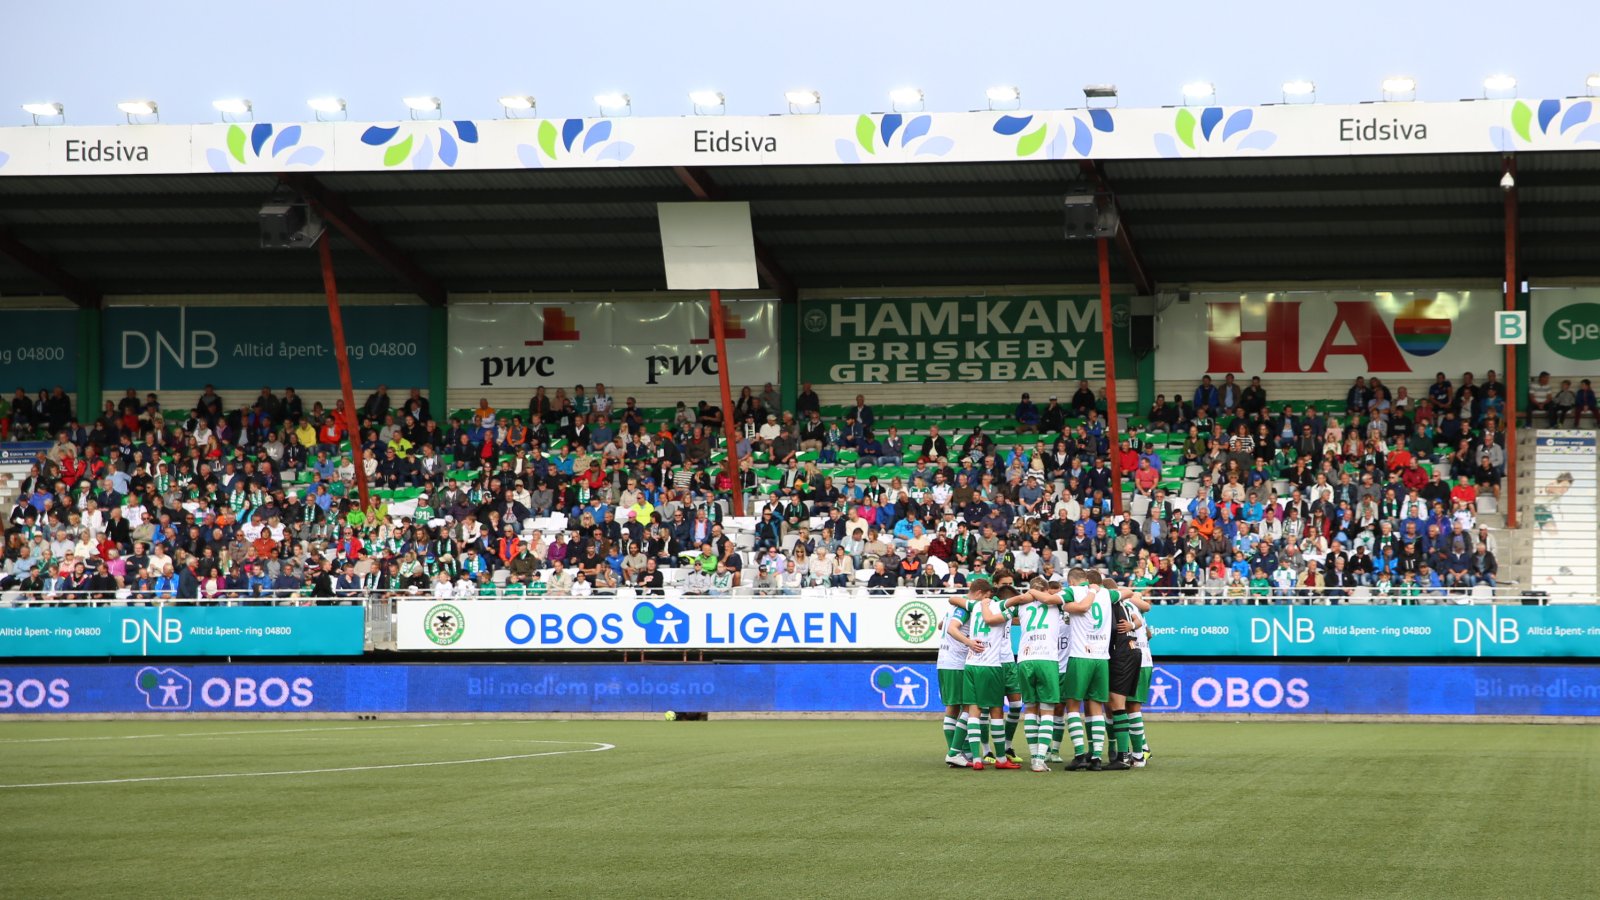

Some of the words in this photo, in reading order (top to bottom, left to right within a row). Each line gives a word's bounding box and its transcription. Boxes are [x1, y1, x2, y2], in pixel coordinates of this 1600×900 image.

[694, 129, 777, 153] Eidsiva
[1340, 118, 1427, 142] Eidsiva
[66, 139, 149, 162] Eidsiva
[830, 299, 1105, 336] HAM-KAM
[1500, 314, 1522, 339] B
[1557, 319, 1600, 345] Spe
[0, 349, 12, 365] g
[17, 347, 65, 361] 04800
[121, 306, 219, 390] DNB
[233, 342, 274, 357] Alltid
[369, 342, 417, 357] 04800
[849, 339, 1086, 361] BRISKEBY
[480, 355, 555, 386] pwc
[646, 354, 719, 385] pwc
[829, 360, 1107, 383] GRESSBANE
[973, 612, 991, 637] 14
[1026, 603, 1049, 632] 22
[1091, 601, 1103, 630] 9
[0, 627, 22, 637] Alltid
[54, 626, 72, 638] ring
[74, 627, 101, 636] 04800
[121, 606, 183, 656] DNB
[190, 626, 213, 635] Alltid
[245, 626, 263, 637] ring
[265, 626, 292, 635] 04800
[504, 612, 624, 645] OBOS
[705, 612, 857, 644] LIGAEN
[1180, 626, 1199, 636] ring
[1201, 626, 1229, 635] 04800
[1251, 605, 1316, 657] DNB
[1323, 626, 1347, 635] Alltid
[1381, 626, 1400, 637] ring
[1402, 626, 1431, 635] 04800
[1453, 605, 1520, 657] DNB
[1527, 626, 1553, 635] Alltid
[201, 677, 314, 708] OBOS
[467, 677, 494, 695] Bli
[500, 676, 588, 696] medlem
[626, 677, 715, 696] obos.no
[1191, 677, 1310, 709] OBOS
[1475, 679, 1502, 697] Bli
